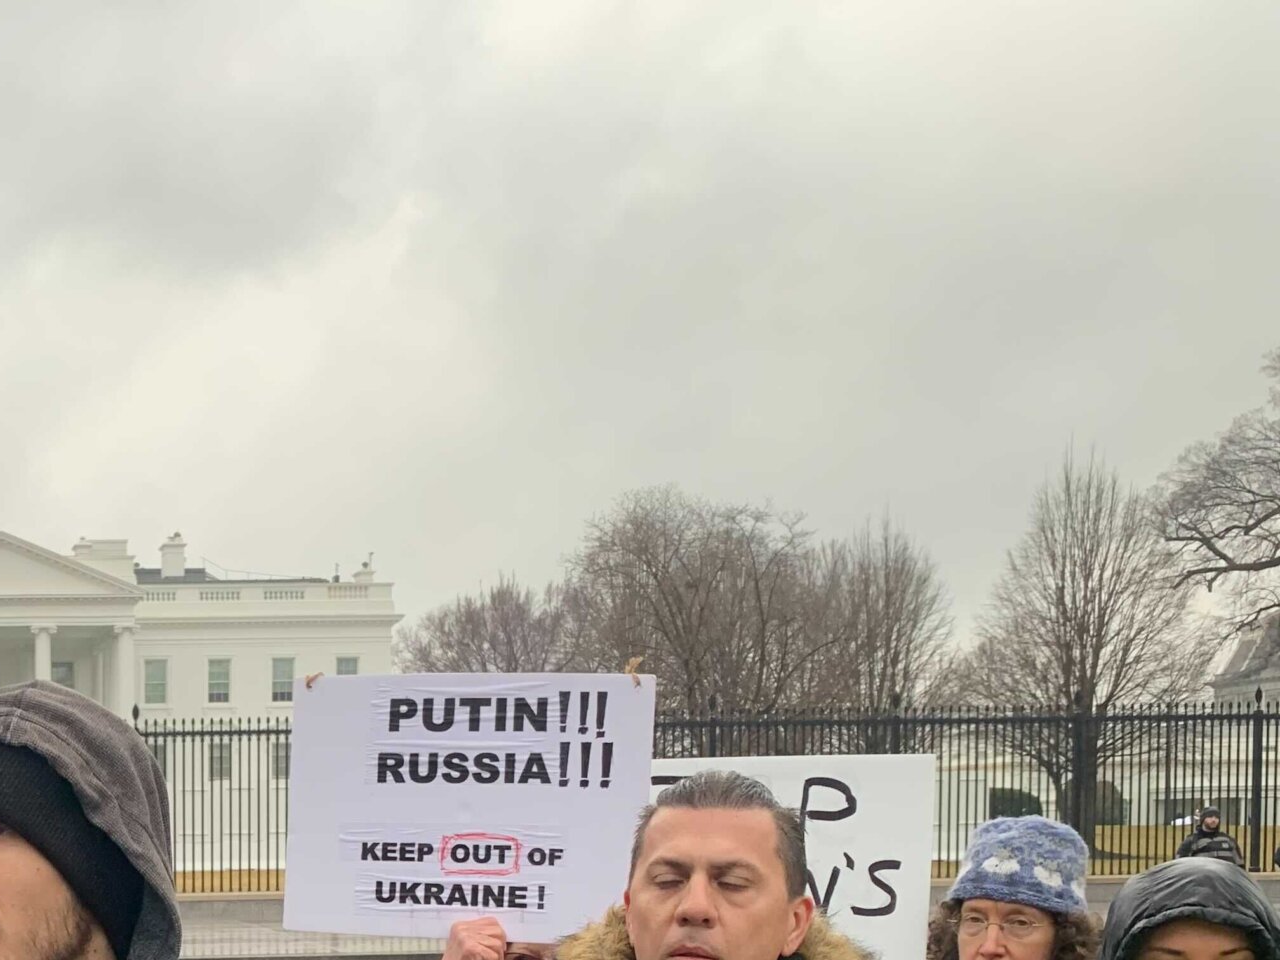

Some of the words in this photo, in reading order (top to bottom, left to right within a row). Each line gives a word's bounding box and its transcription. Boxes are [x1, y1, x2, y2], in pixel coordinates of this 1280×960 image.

[388, 691, 608, 738] PUTIN!!!
[376, 742, 614, 788] RUSSIA!!!
[361, 842, 434, 862] KEEP
[450, 843, 512, 864] OUT
[527, 847, 564, 866] OF
